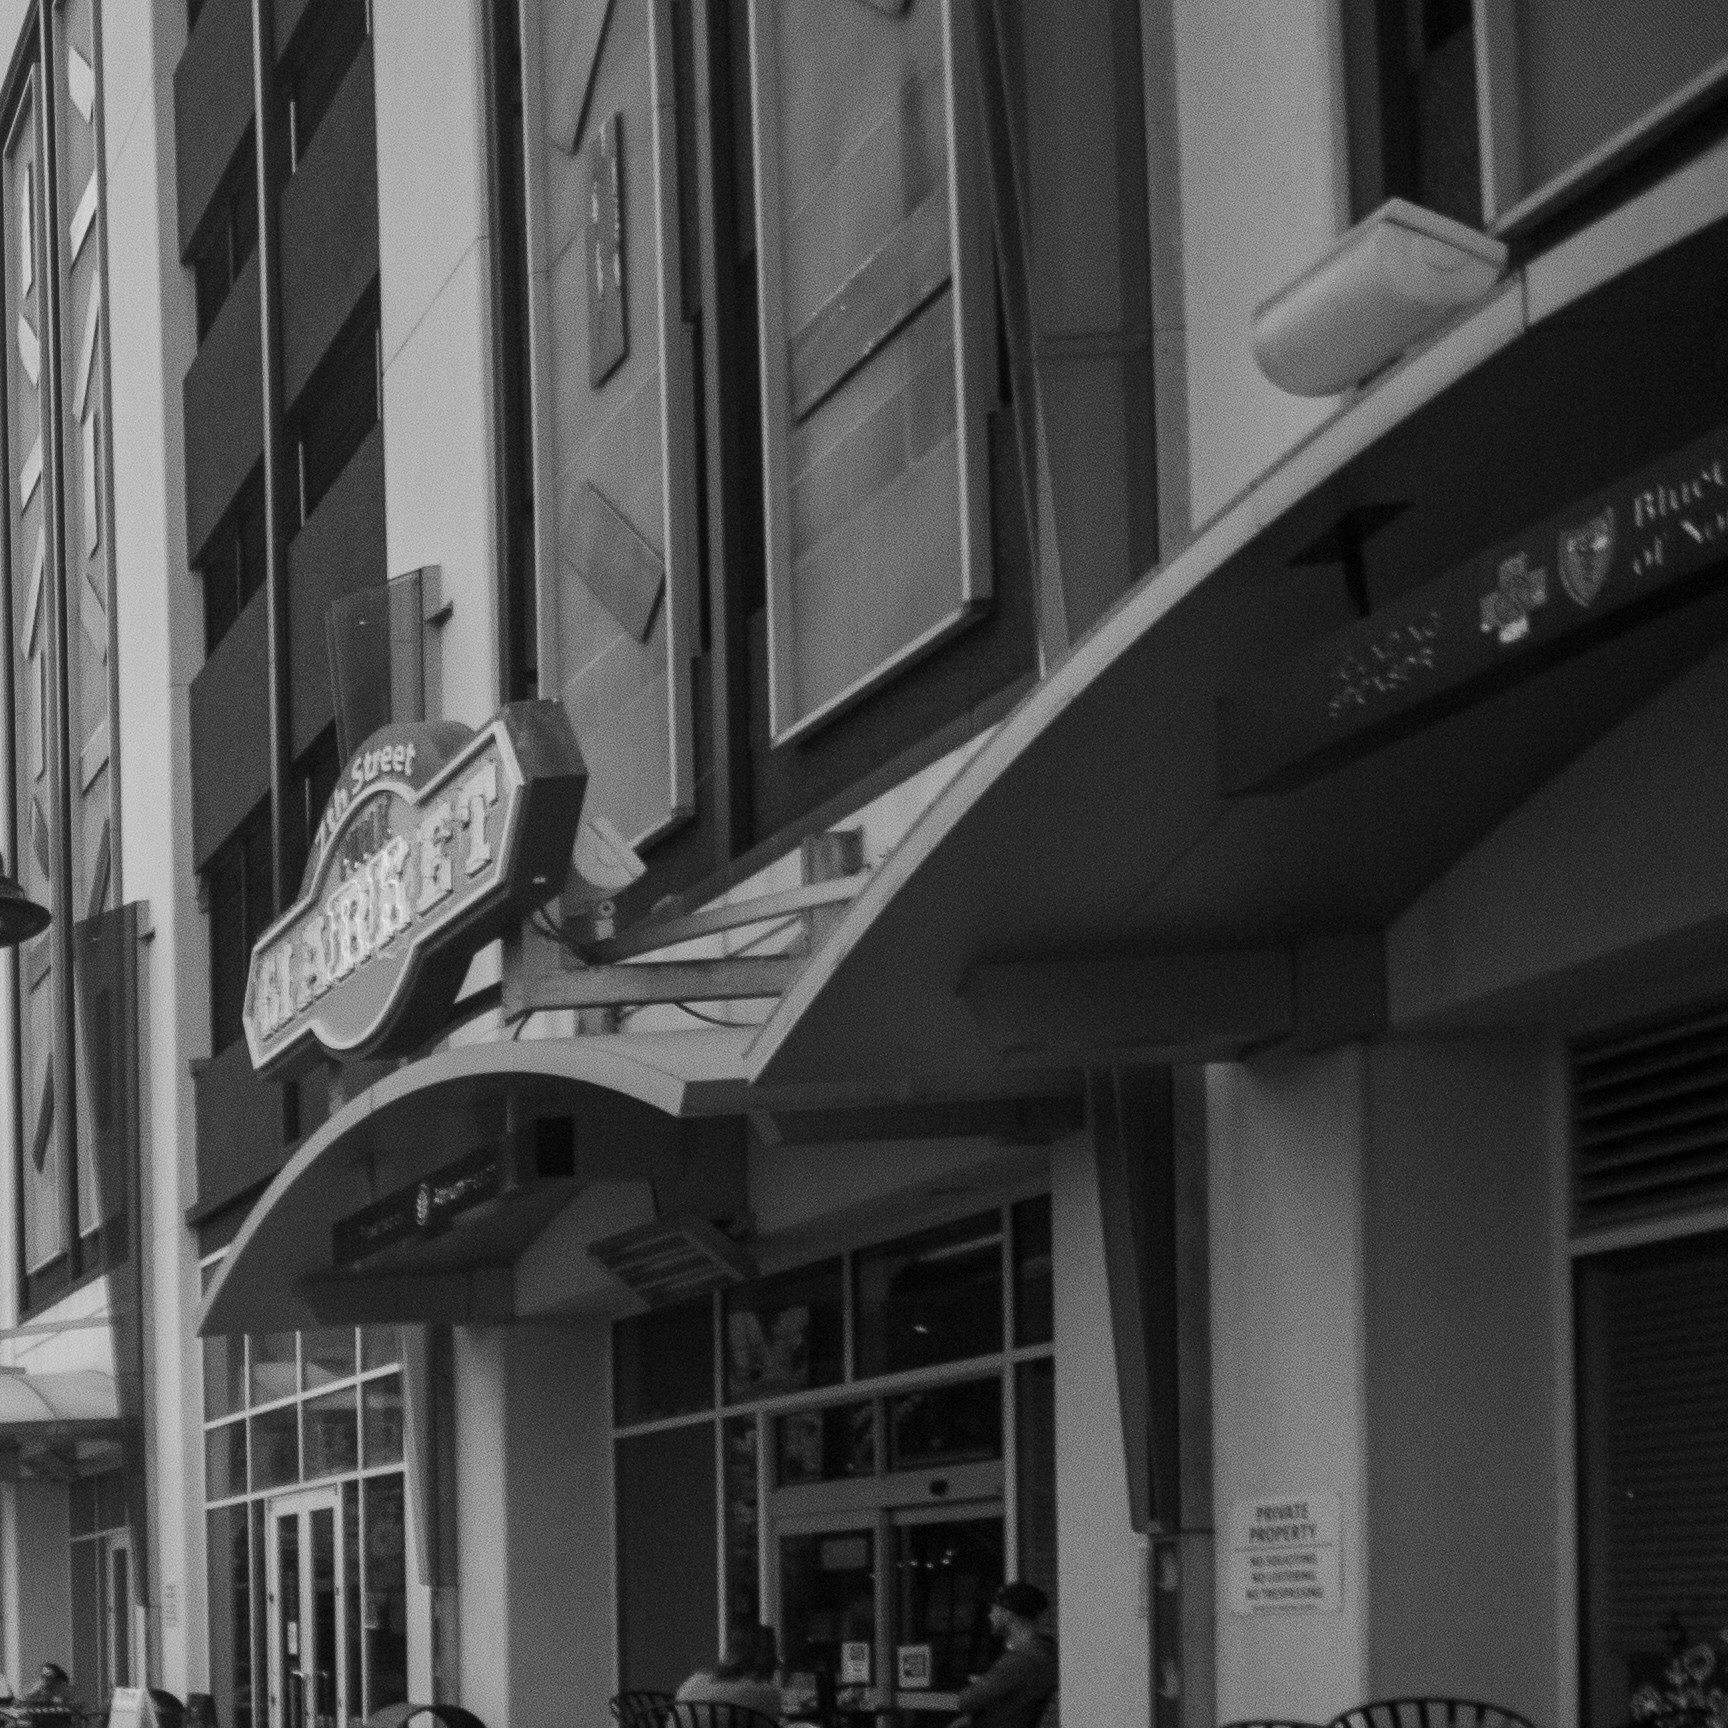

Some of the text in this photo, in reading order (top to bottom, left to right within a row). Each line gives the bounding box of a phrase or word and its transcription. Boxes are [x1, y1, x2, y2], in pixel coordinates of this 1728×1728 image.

[1632, 533, 1665, 576] of
[313, 787, 349, 856] 7th
[351, 742, 416, 795] Street
[256, 757, 497, 1039] MARKET
[1256, 1502, 1309, 1522] PRIVATE
[1249, 1523, 1316, 1544] PROPERTY
[1250, 1556, 1265, 1567] NO
[1252, 1573, 1266, 1583] NO
[1246, 1589, 1260, 1600] NO
